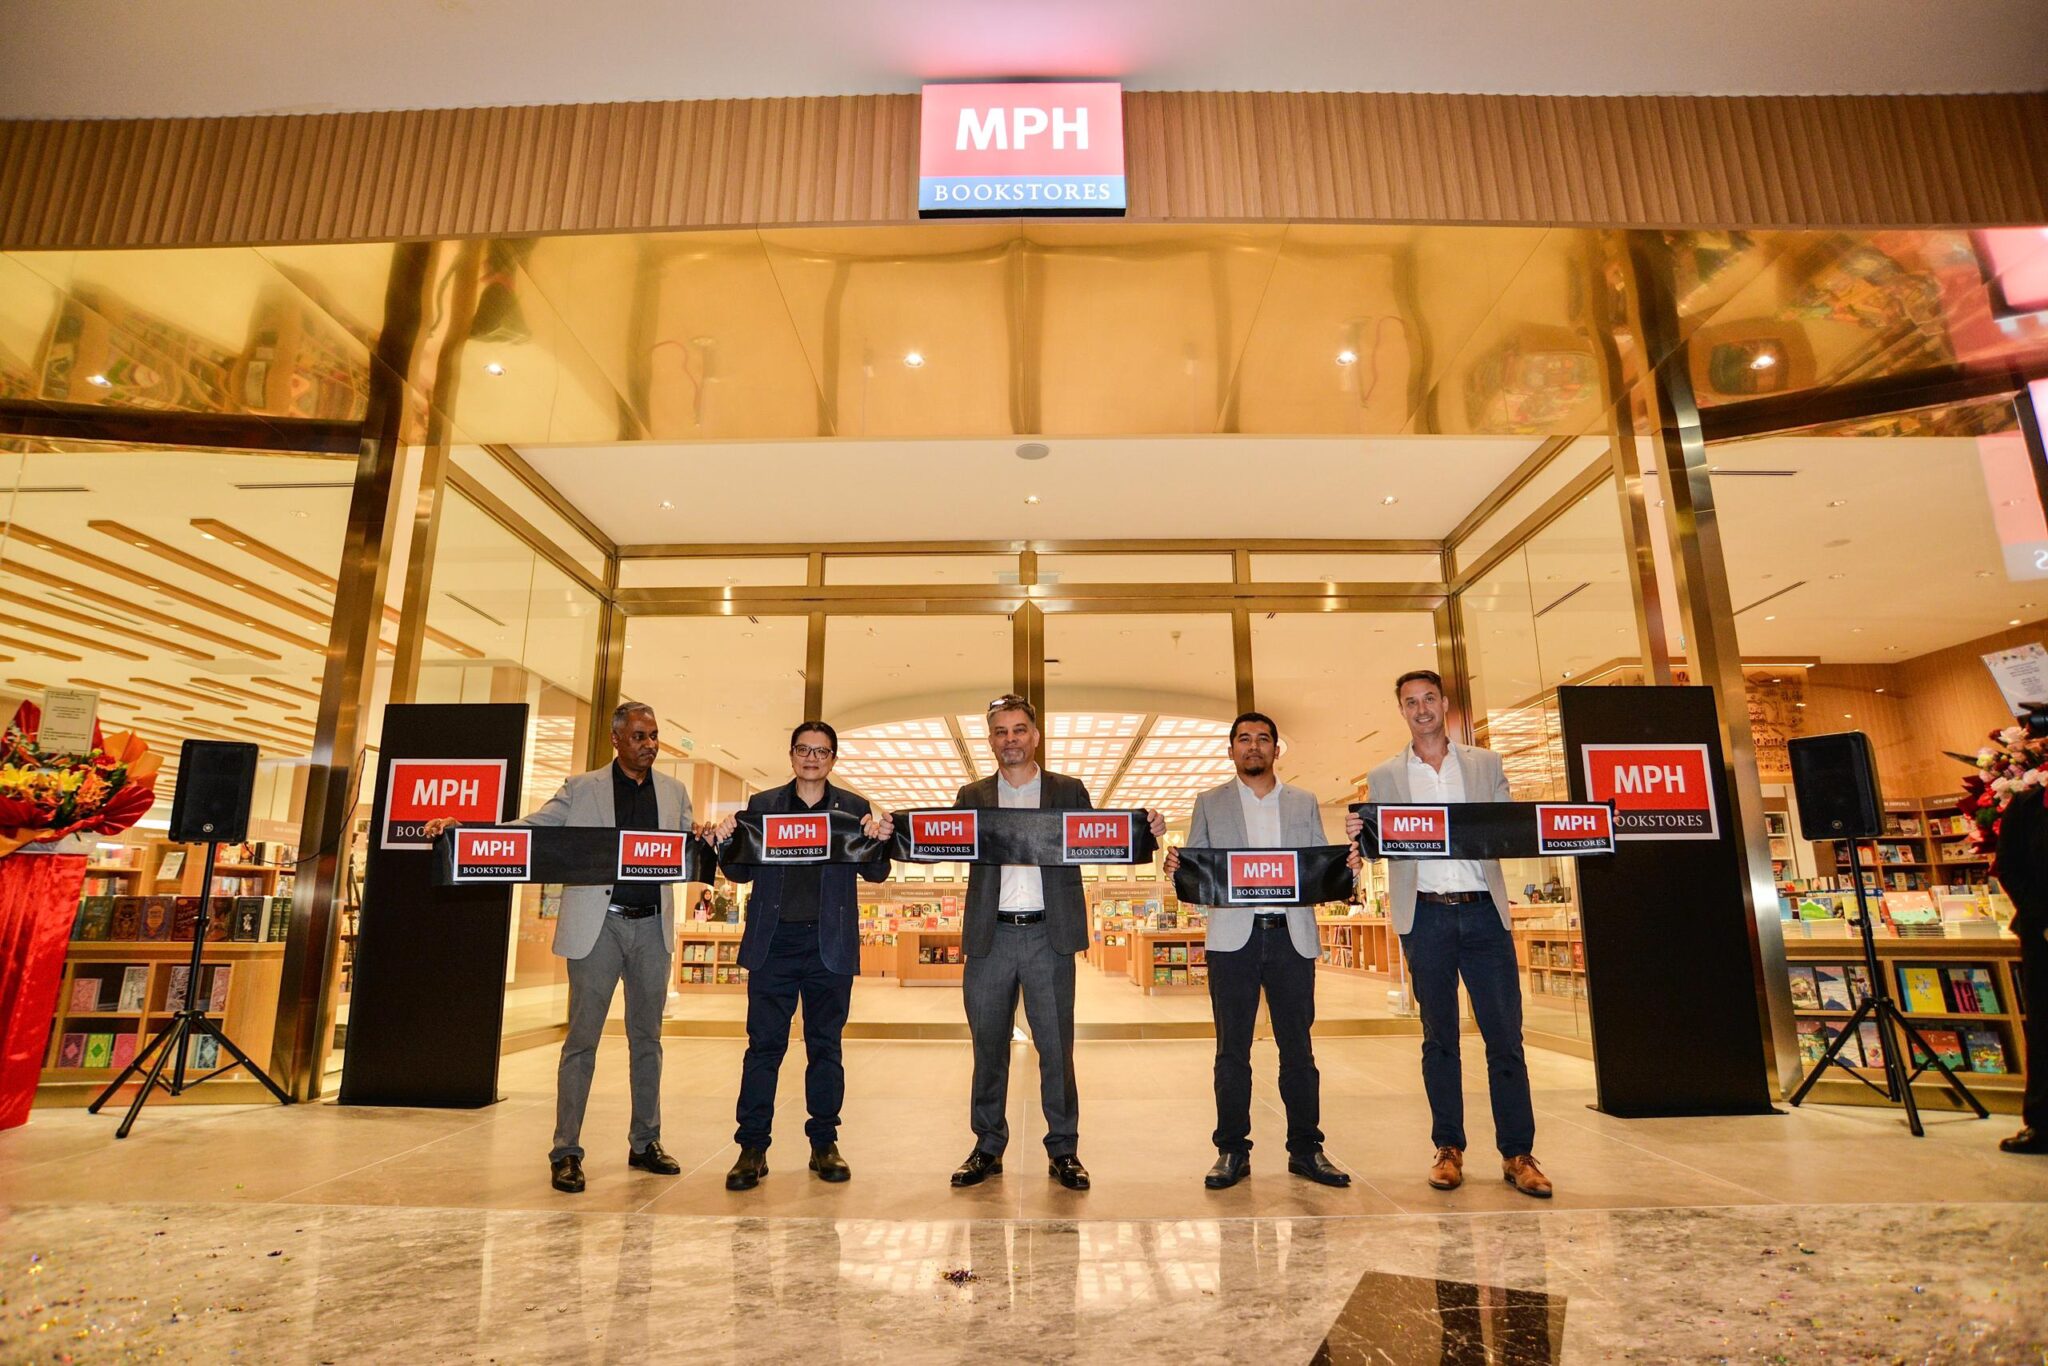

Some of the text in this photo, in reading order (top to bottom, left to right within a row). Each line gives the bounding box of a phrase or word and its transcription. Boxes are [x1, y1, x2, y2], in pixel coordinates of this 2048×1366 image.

[956, 107, 1089, 150] MPH
[934, 183, 1111, 202] BOOKSTORES
[1614, 765, 1686, 794] MPH
[411, 778, 480, 806] MPH
[924, 820, 963, 837] MPH
[1393, 816, 1434, 832] MPH
[1553, 815, 1597, 831] MPH
[1616, 815, 1703, 827] OOKSTORES
[778, 823, 817, 840] MPH
[1078, 822, 1117, 839] MPH
[471, 840, 515, 857] MPH
[633, 841, 672, 858] MPH
[770, 847, 823, 856] BOOKSTORES
[919, 846, 970, 854] BOOKSTORES
[1386, 841, 1442, 850] BOOKSTORES
[1547, 838, 1607, 849] BOOKSTORES
[1071, 848, 1125, 857] BOOKSTORES
[462, 866, 522, 874] BOOKSTORES
[625, 866, 679, 874] BOOKSTORES
[1244, 862, 1282, 878] MPH
[1236, 888, 1291, 896] BOOKSTORES
